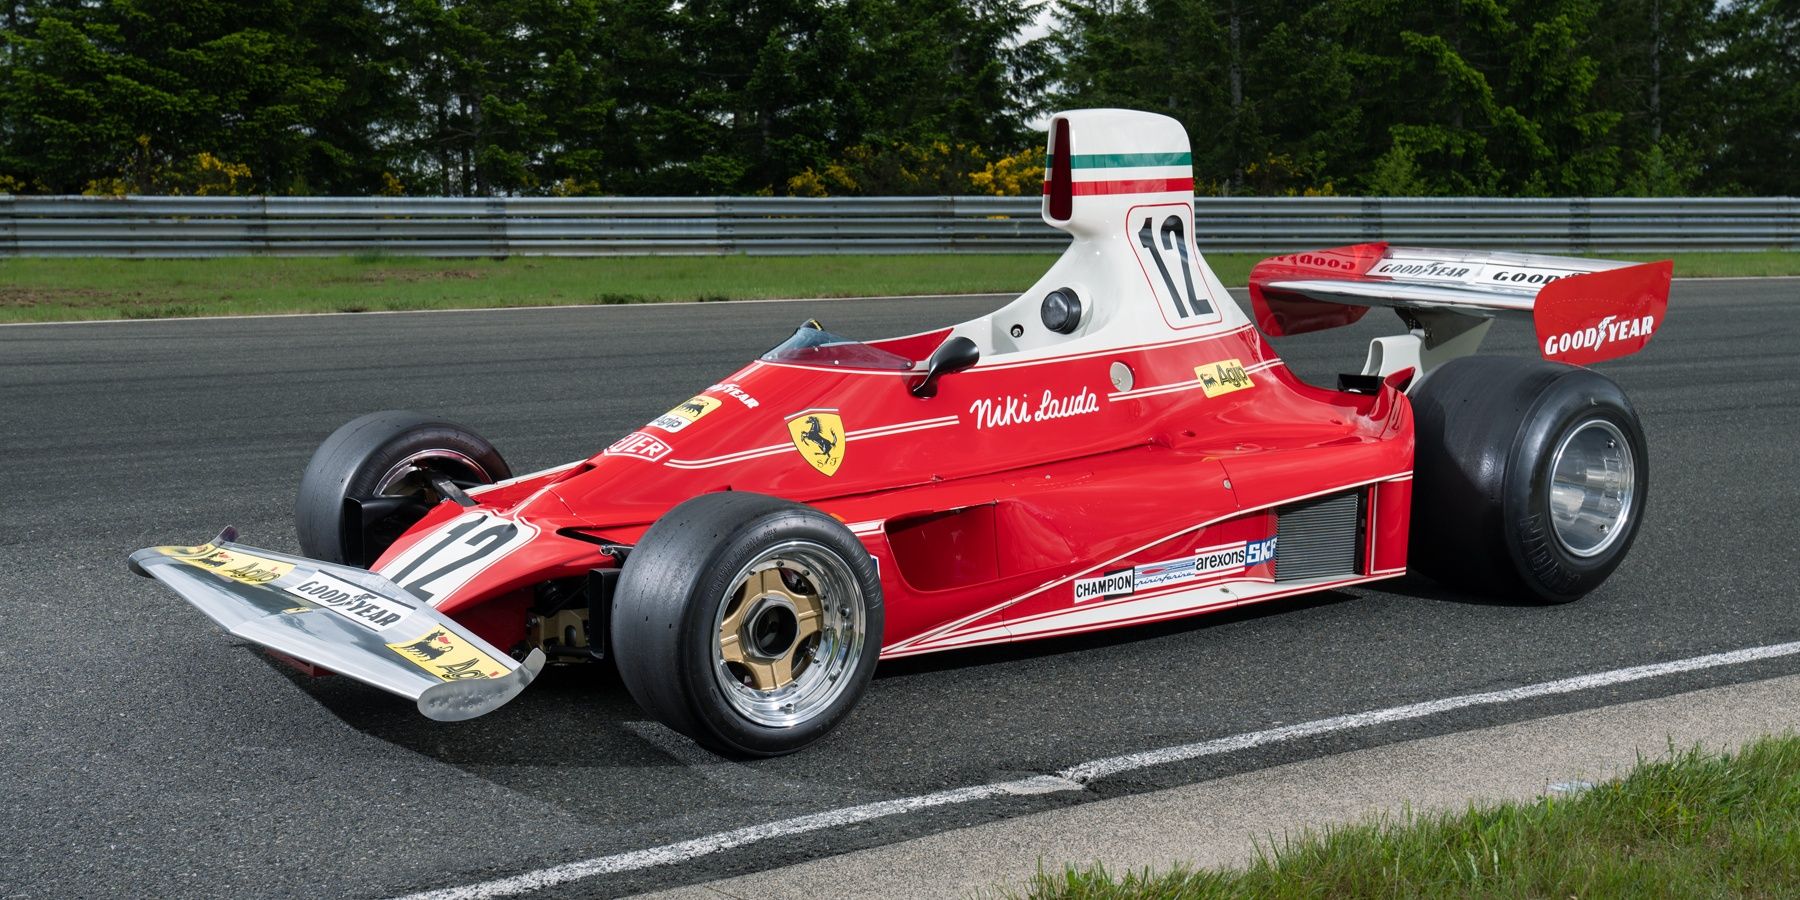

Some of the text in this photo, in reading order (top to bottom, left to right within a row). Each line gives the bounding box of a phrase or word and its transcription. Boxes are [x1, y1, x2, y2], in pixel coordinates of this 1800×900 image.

[1138, 214, 1214, 319] 12
[1378, 262, 1470, 278] GOODYEAR
[1545, 315, 1654, 356] GOODYEAR
[1216, 362, 1248, 387] Agip
[1034, 386, 1100, 422] Lauda
[609, 432, 665, 457] UER
[390, 515, 518, 597] 12
[1195, 550, 1245, 571] arexons
[1247, 537, 1278, 563] SKF
[1076, 575, 1132, 598] CHAMPION
[297, 581, 401, 627] GOODYEAR
